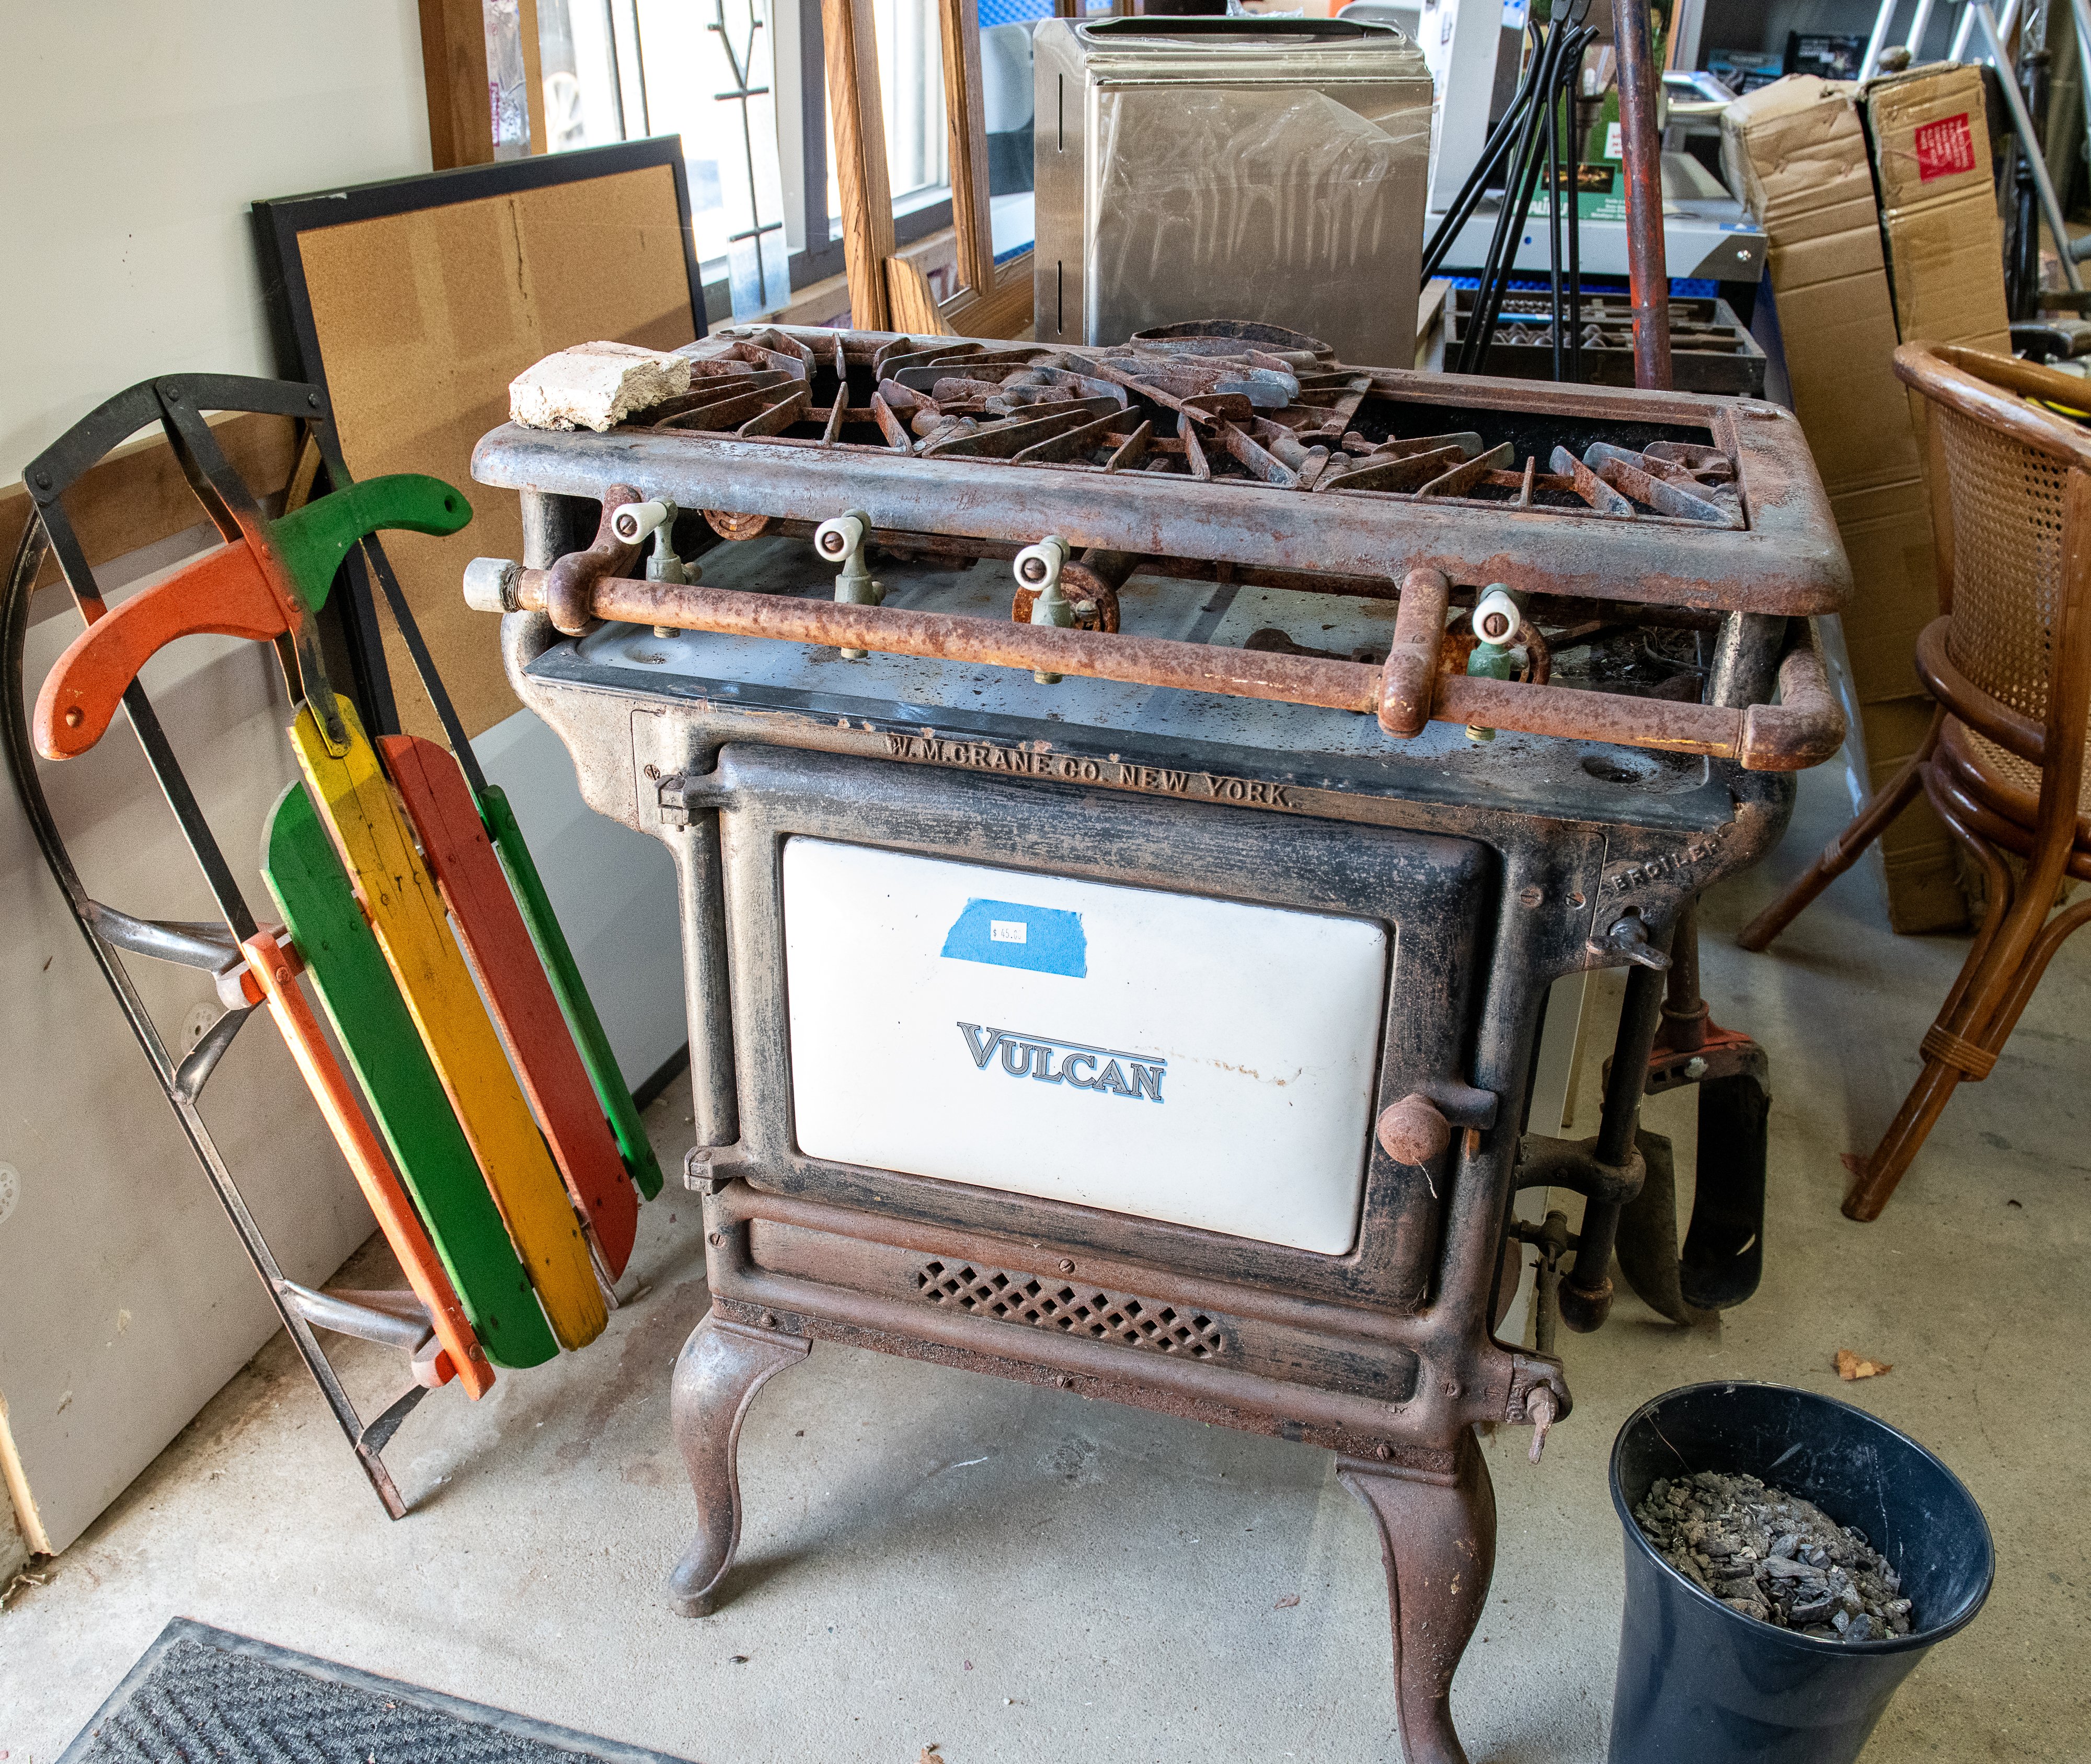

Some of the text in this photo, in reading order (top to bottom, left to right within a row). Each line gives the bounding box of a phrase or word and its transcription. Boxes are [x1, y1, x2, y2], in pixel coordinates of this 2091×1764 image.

[1120, 765, 1189, 793] NEW
[1611, 837, 1720, 892] BROILER
[957, 1022, 1167, 1104] VULCAN
